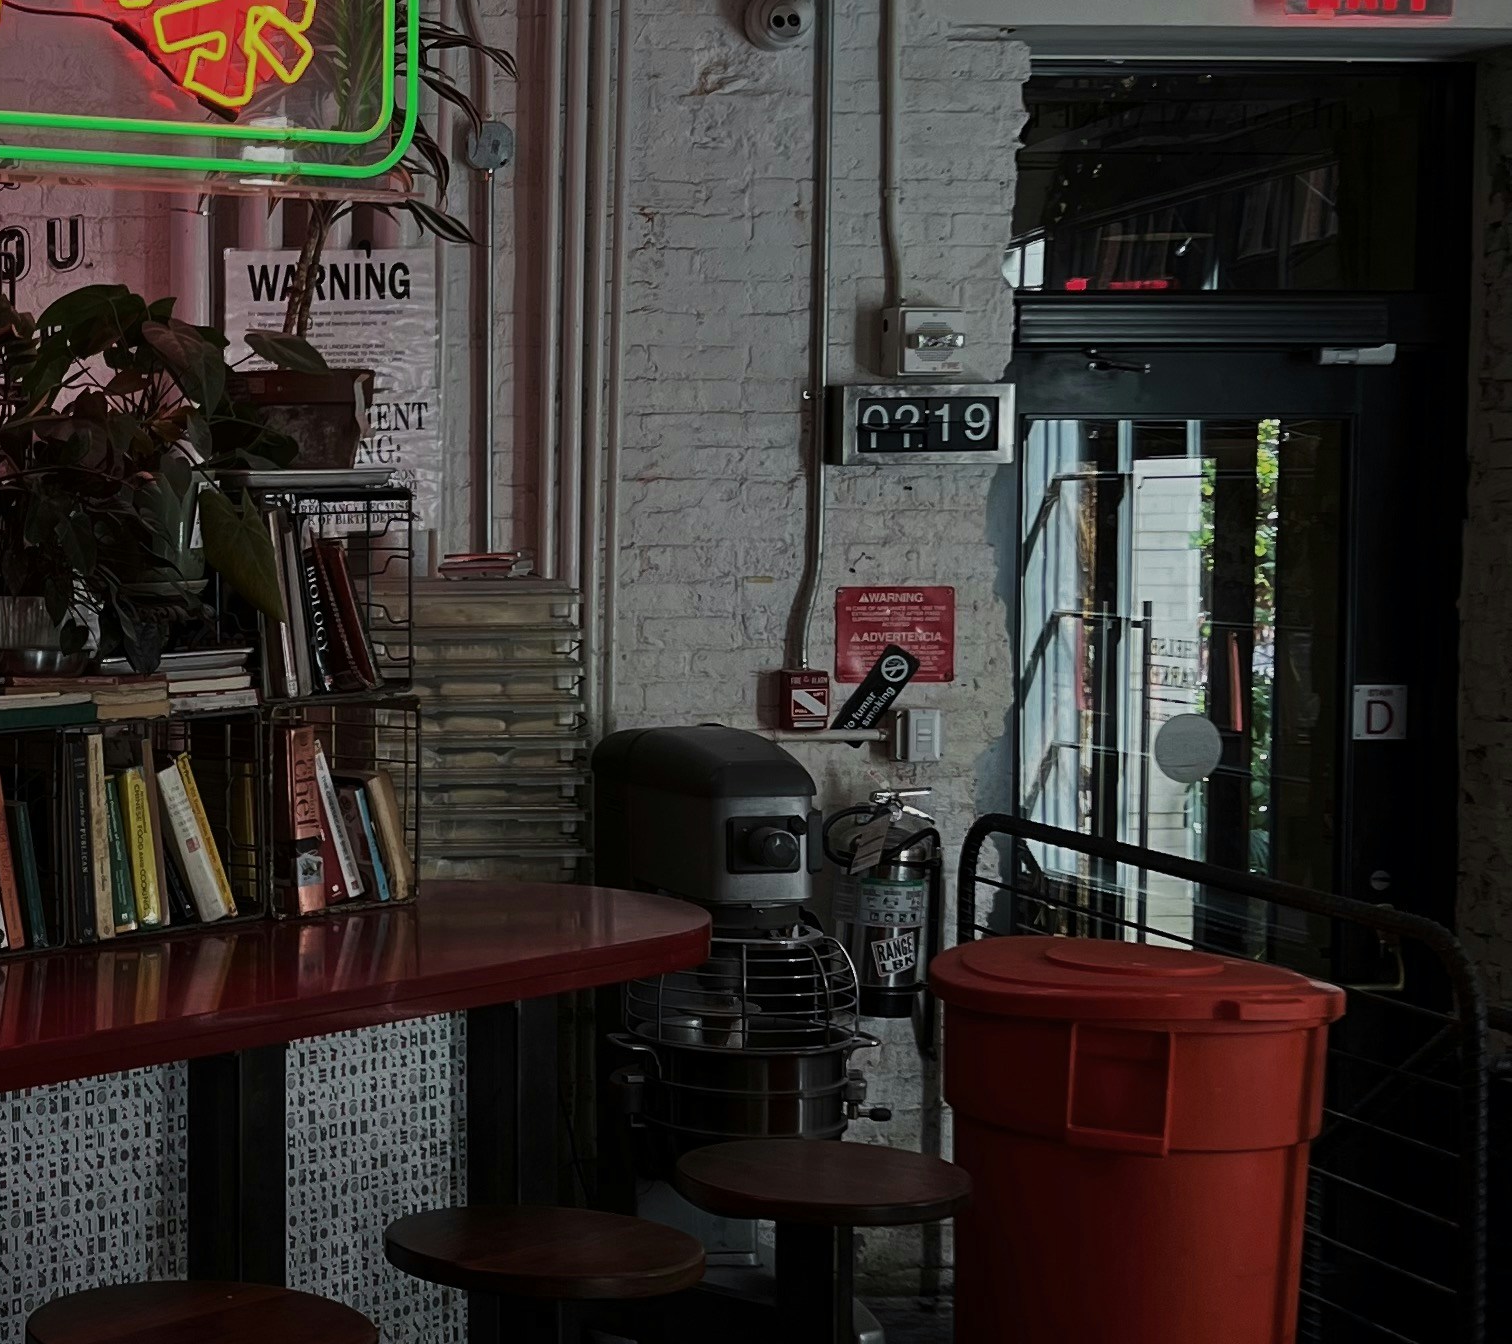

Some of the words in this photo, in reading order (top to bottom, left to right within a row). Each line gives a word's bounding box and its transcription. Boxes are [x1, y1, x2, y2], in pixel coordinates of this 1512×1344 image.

[247, 262, 411, 302] WARNING
[306, 565, 330, 653] BIOLOGY
[868, 592, 925, 603] WARNING
[860, 631, 942, 643] ADVERTENCIA
[853, 689, 879, 720] fumar
[861, 685, 896, 726] smoking
[1366, 699, 1393, 736] D
[80, 828, 89, 874] PUBLICAN
[136, 822, 145, 852] FOOD
[139, 867, 152, 912] COOKING
[876, 935, 914, 963] RANGE
